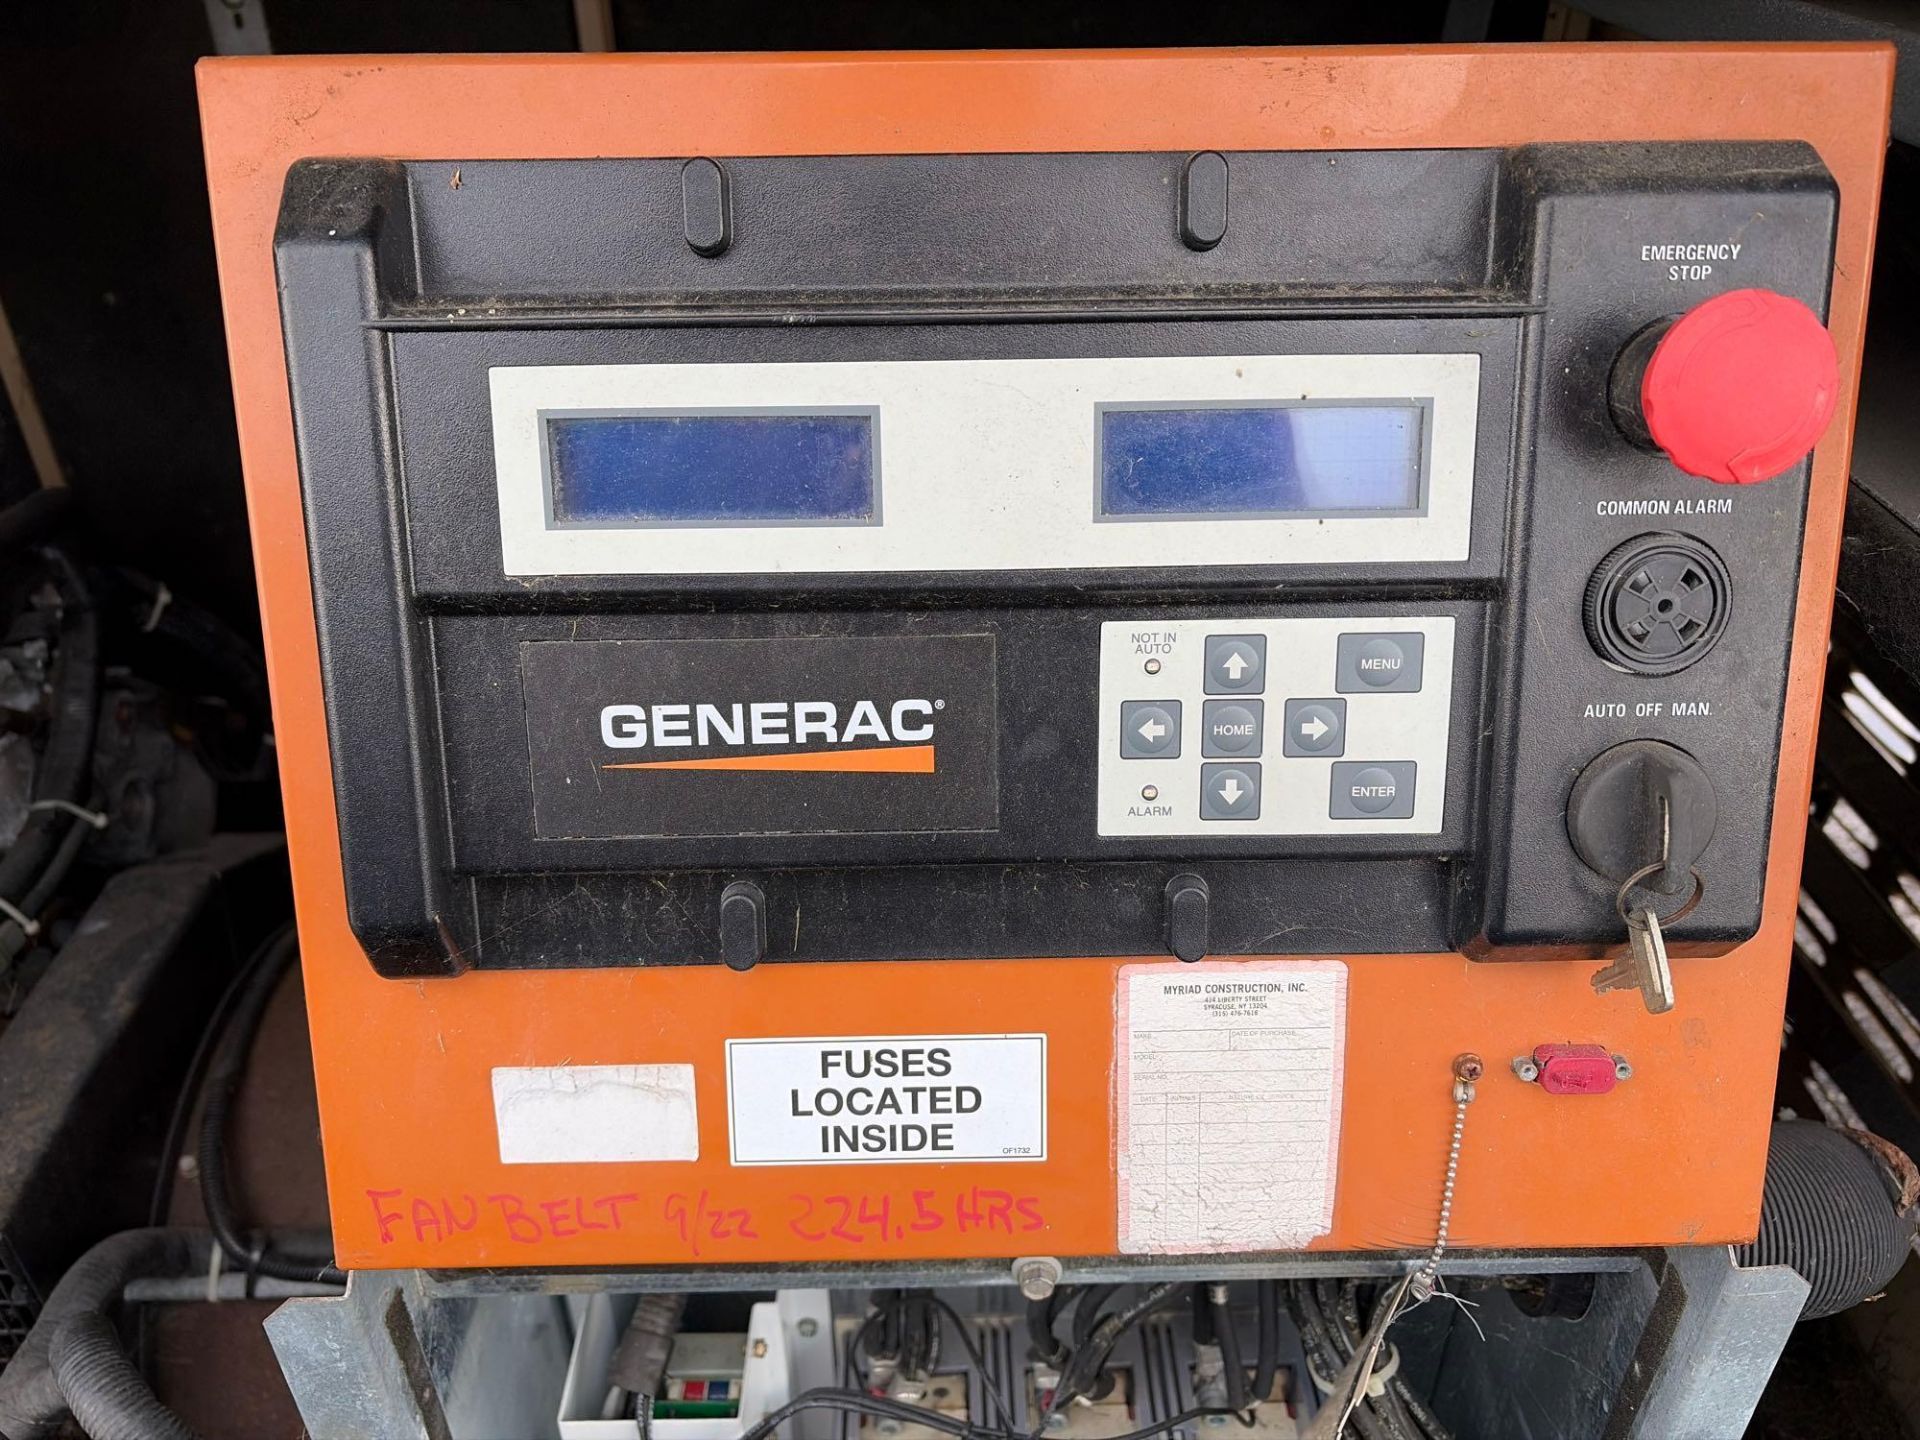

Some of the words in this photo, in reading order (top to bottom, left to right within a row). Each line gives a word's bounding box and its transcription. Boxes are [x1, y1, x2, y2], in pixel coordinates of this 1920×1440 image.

[1641, 244, 1741, 261] EMERGENCY
[1668, 265, 1712, 280] STOP
[1597, 500, 1670, 515] COMMON
[1674, 499, 1732, 514] ALARM
[1131, 632, 1160, 644] NOT
[1163, 632, 1177, 643] IN
[1135, 643, 1172, 655] AUTO
[1361, 658, 1401, 670] MENU
[1584, 703, 1626, 718] AUTO
[1635, 702, 1663, 717] OFF
[1671, 702, 1713, 717] MAN.
[600, 699, 935, 749] GENERAC
[1213, 724, 1254, 736] HOME
[1352, 785, 1396, 797] ENTER
[1127, 805, 1172, 817] ALARM
[1163, 985, 1202, 995] MYRIAD
[1205, 983, 1284, 994] CONSTRUCTION,
[1288, 982, 1308, 993] INC.
[821, 1048, 952, 1079] FUSES
[791, 1086, 982, 1117] LOCATED
[821, 1123, 954, 1153] INSIDE
[366, 1189, 479, 1244] FAN
[488, 1194, 639, 1244] BELT
[663, 1189, 759, 1257] 9/22
[789, 1190, 945, 1243] 224.5
